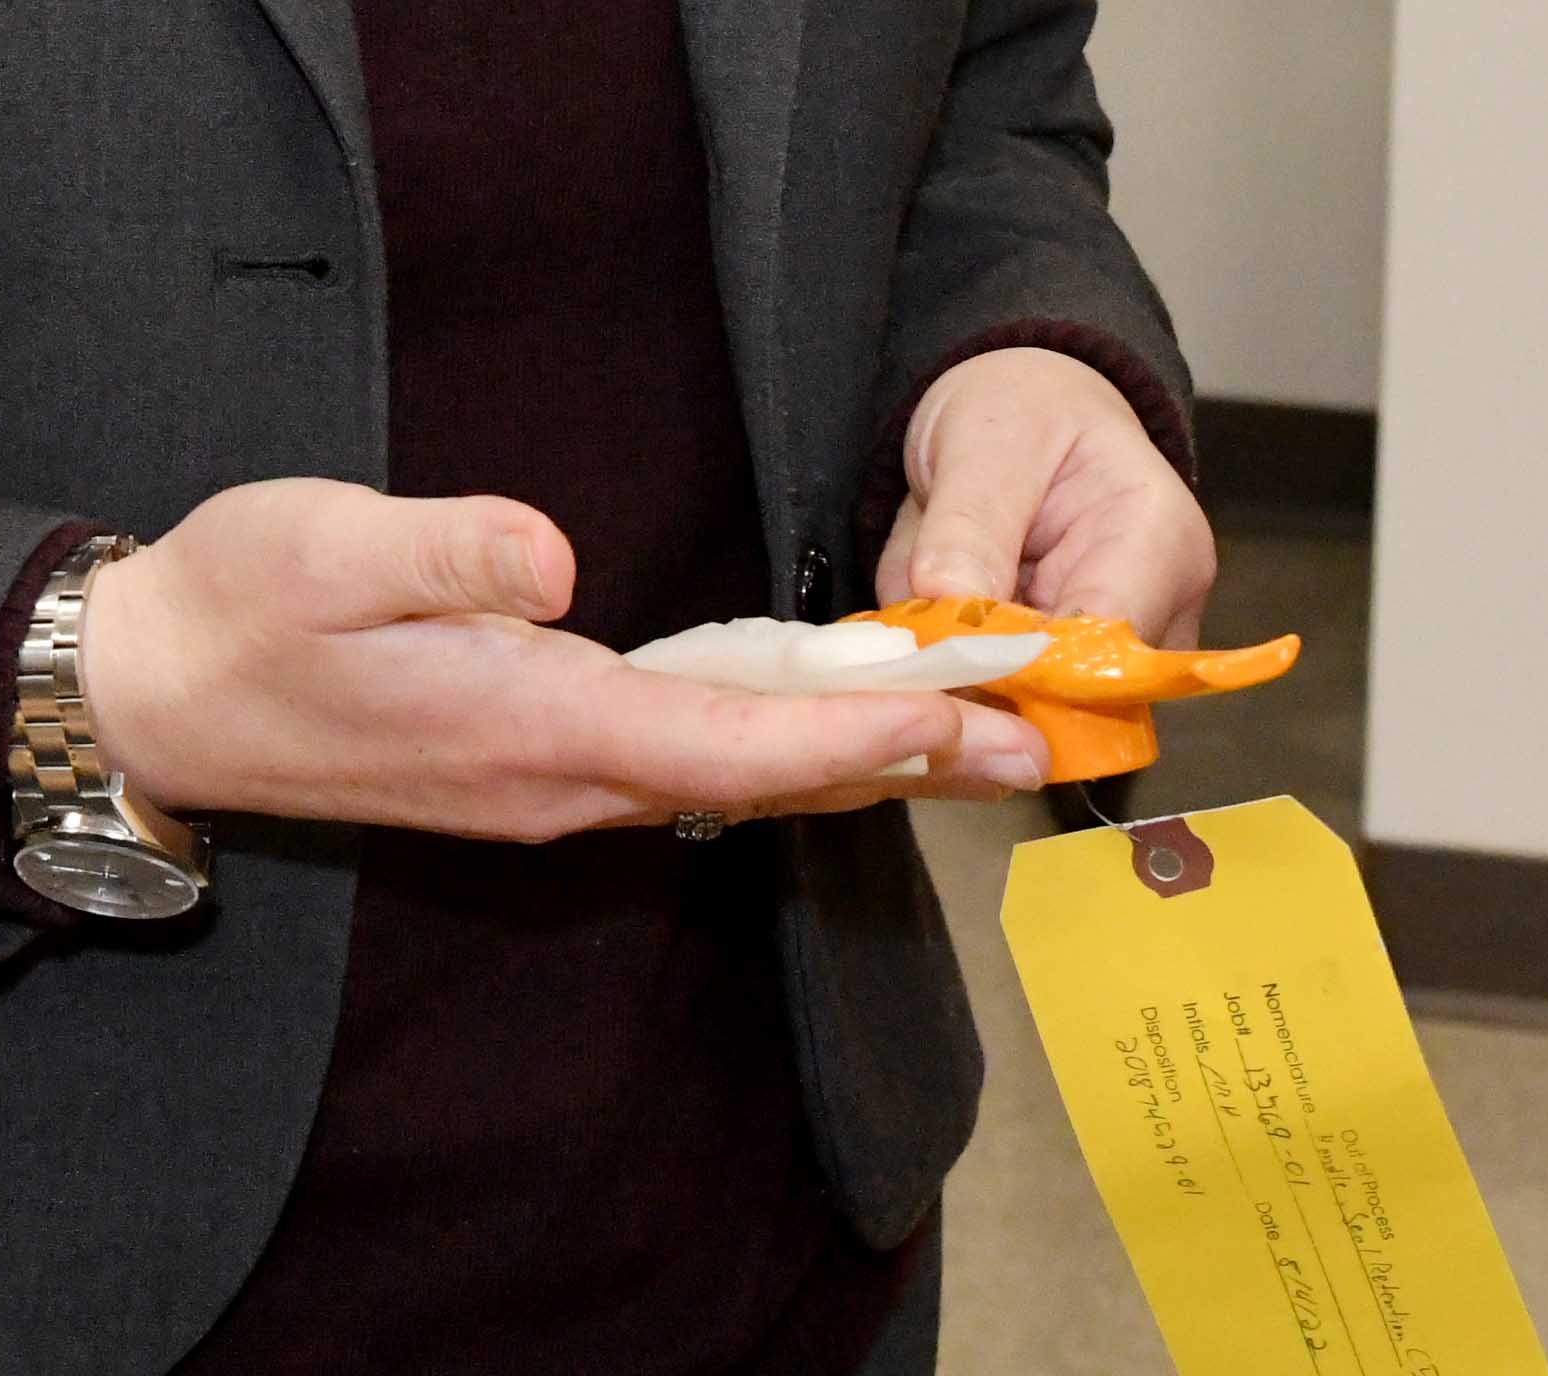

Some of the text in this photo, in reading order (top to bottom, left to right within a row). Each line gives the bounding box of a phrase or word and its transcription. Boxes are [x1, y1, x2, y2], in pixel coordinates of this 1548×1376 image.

[1139, 1005, 1186, 1104] Disposition
[1259, 982, 1317, 1114] Nomenclature
[1254, 1200, 1282, 1244] Date
[1361, 1180, 1395, 1242] Process
